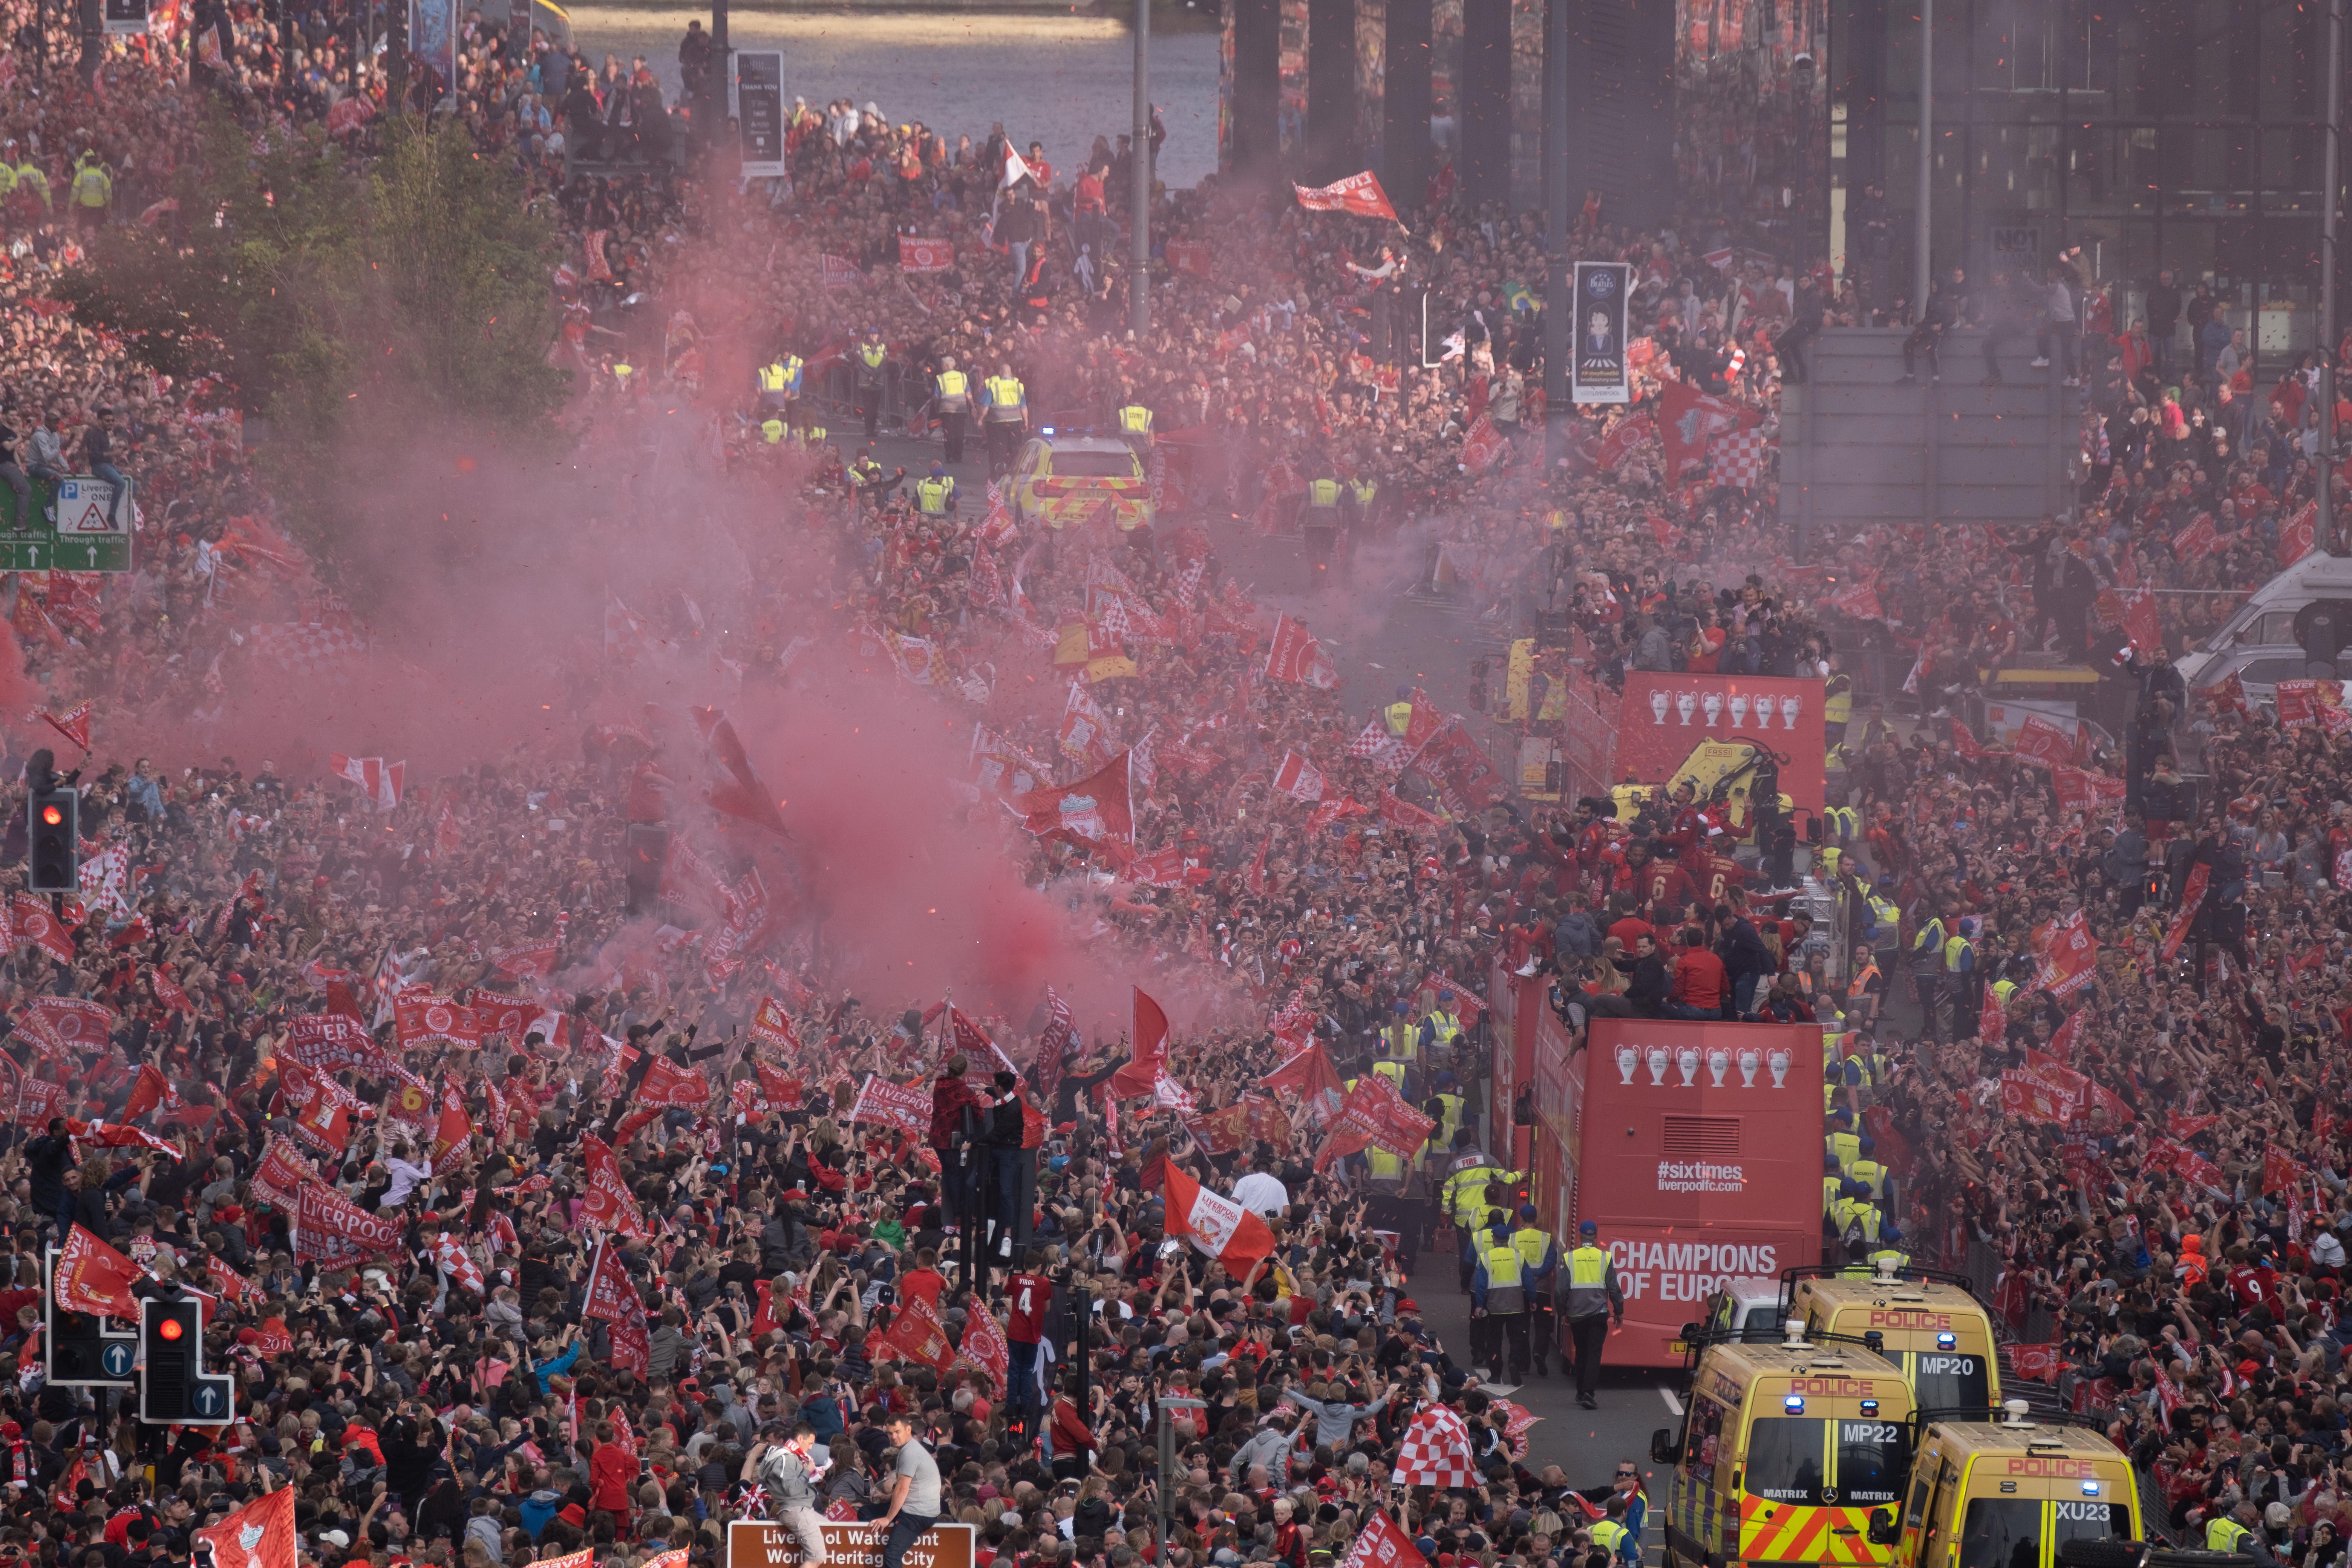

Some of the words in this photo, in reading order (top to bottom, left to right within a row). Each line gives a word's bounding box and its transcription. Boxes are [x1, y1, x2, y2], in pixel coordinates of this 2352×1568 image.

[1590, 278, 1613, 287] BEATLES
[65, 484, 75, 497] P
[81, 484, 113, 493] Liverpo
[20, 531, 47, 539] traffic
[59, 535, 96, 545] Through
[98, 535, 125, 544] traffic
[1276, 636, 1292, 678] LIVERPOOL
[1288, 623, 1297, 636] FC
[1710, 858, 1734, 867] CHAMPIONS
[1652, 876, 1666, 901] 6
[1711, 874, 1725, 899] 6
[478, 992, 536, 1006] LIVERPOO
[1427, 974, 1487, 1010] LIVERPOO
[38, 998, 109, 1016] LIVERPOOL
[398, 997, 452, 1007] LIVERP
[403, 1033, 477, 1048] CHAMPIONS
[752, 1023, 795, 1056] MPIONS
[657, 1056, 696, 1078] LIVERP
[876, 1078, 898, 1089] WE'RE
[900, 1086, 916, 1095] THE
[2003, 1072, 2077, 1104] LIVERPOO
[402, 1087, 423, 1110] 6
[640, 1095, 709, 1109] WINNERS
[871, 1090, 934, 1120] LIVERPOO
[1461, 1156, 1478, 1167] FIRE
[1658, 1161, 1743, 1180] #sixtimes
[1658, 1179, 1742, 1193] liverpoolfc.com
[303, 1187, 326, 1203] WE'RE
[333, 1198, 354, 1211] THE
[1202, 1194, 1239, 1221] LIVERPOOL
[301, 1199, 400, 1242] LIVERPOOL
[1222, 1214, 1236, 1224] FINAL
[323, 1256, 361, 1272] MADRID
[1610, 1242, 1776, 1274] CHAMPIONS
[210, 1258, 267, 1306] LIVERPO
[1019, 1278, 1035, 1286] VIRGIL
[2237, 1268, 2255, 1279] FIRMINO
[1615, 1272, 1651, 1299] OF
[2248, 1280, 2263, 1301] 9
[1018, 1288, 1032, 1317] 4
[594, 1306, 620, 1319] FINAL
[1870, 1311, 1951, 1330] POLICE
[1923, 1357, 1974, 1376] MP20
[1791, 1379, 1873, 1397] POLICE
[1844, 1424, 1897, 1443] MP22
[2008, 1458, 2093, 1478] POLICE
[1763, 1489, 1808, 1499] MATRIX
[1851, 1490, 1894, 1501] MATRIX
[2056, 1502, 2110, 1521] XU23
[763, 1529, 841, 1545] Liveol
[848, 1530, 939, 1546] Wateont
[766, 1549, 804, 1564] Worl
[824, 1549, 884, 1567] Heritag
[902, 1550, 935, 1568] City
